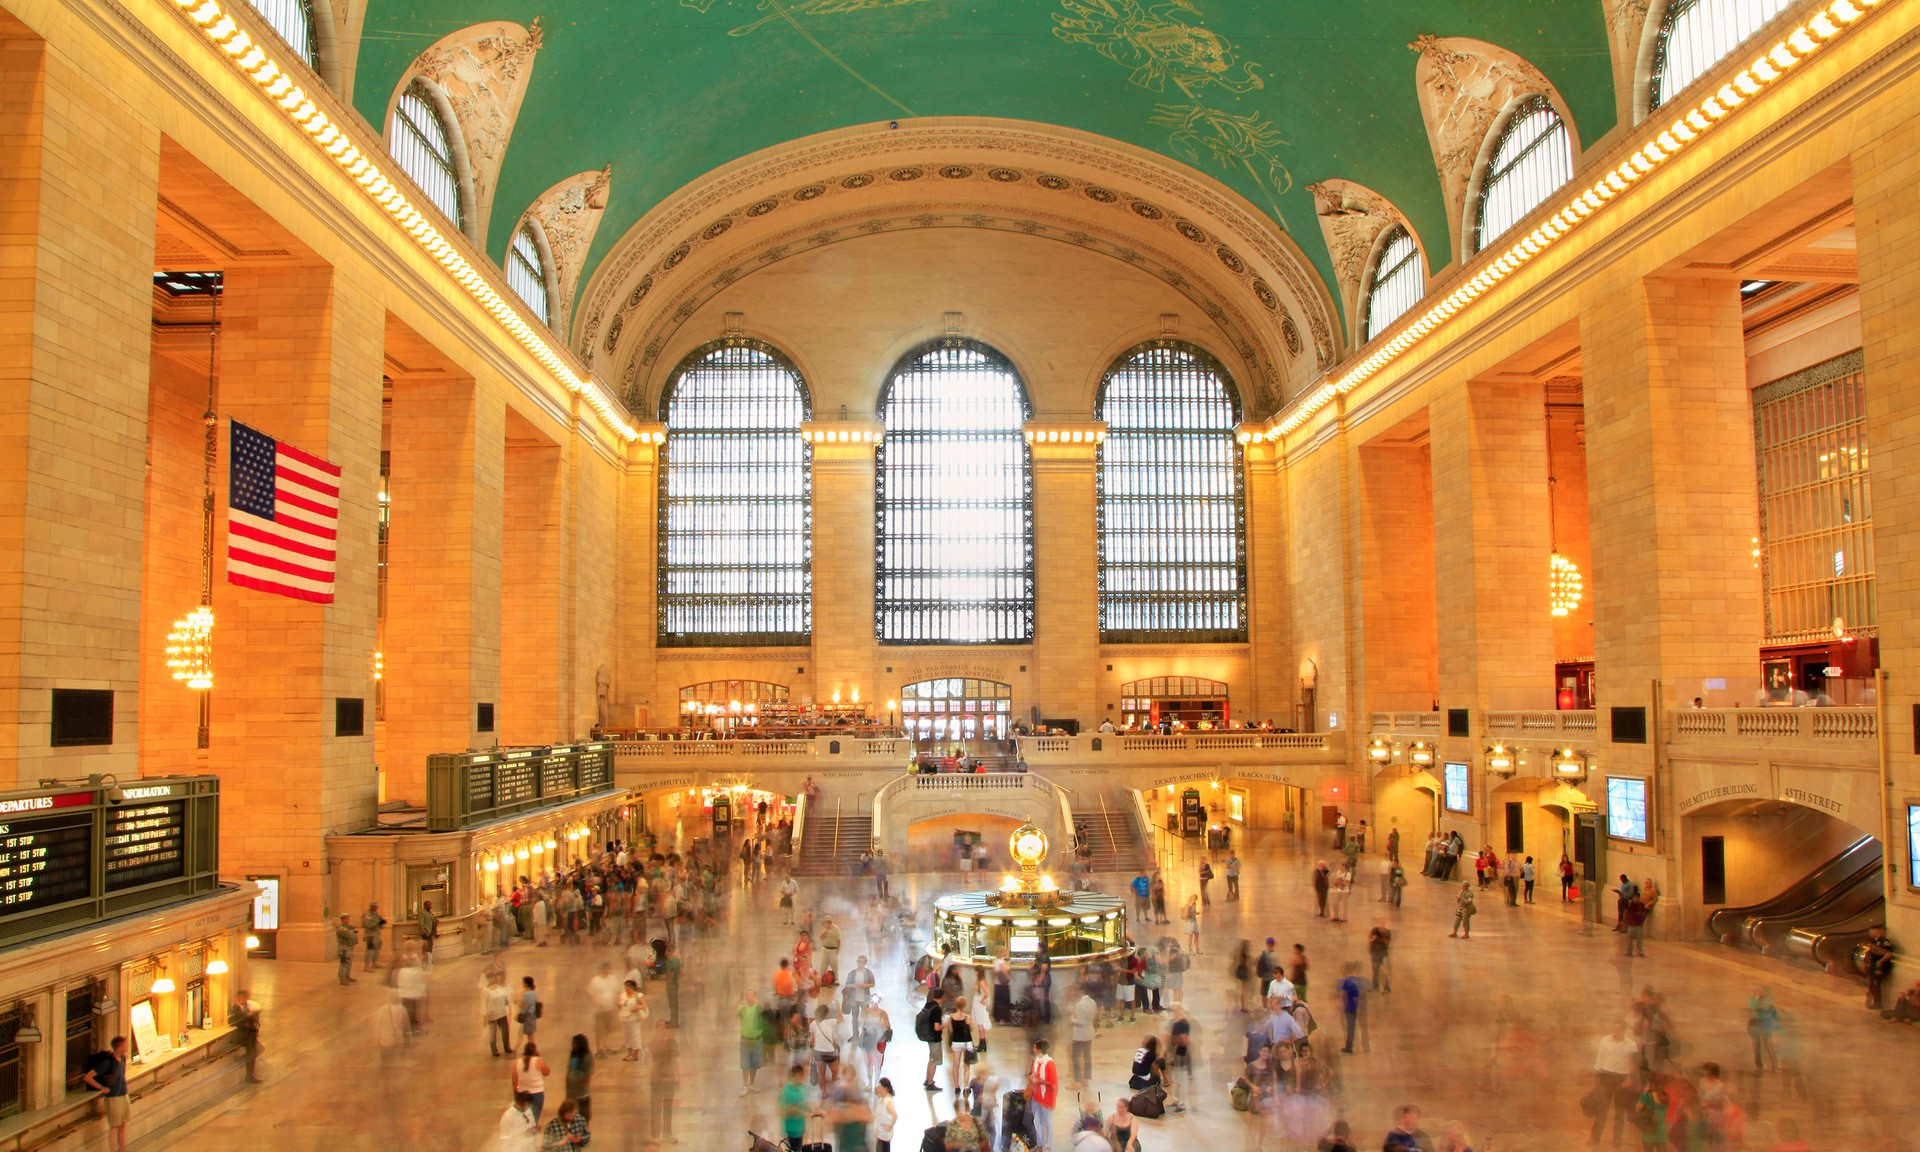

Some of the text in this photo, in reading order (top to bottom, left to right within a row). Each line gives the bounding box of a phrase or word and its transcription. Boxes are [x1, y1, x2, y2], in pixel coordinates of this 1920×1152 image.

[926, 664, 968, 672] VANDERBILT
[973, 665, 1000, 674] AVENUE
[965, 671, 1005, 681] APARTMENT
[629, 778, 691, 792] SUBWAY SHUTTLE
[1154, 772, 1214, 786] TICKET MACHINES
[123, 786, 171, 799] NFORMATION
[1679, 784, 1758, 811] THE METLIFE BUILDING
[1784, 787, 1843, 813] 45TH STREET
[6, 836, 34, 848] 1ST STOP
[20, 850, 30, 860] 1ST
[32, 848, 46, 858] STOP
[108, 861, 117, 870] SEE
[150, 854, 159, 862] FOR
[160, 850, 178, 860] DETAILS
[20, 864, 30, 874] 1ST
[32, 862, 46, 872] STOP
[6, 877, 33, 890] 1ST STOP
[6, 891, 33, 904] 1ST STOP
